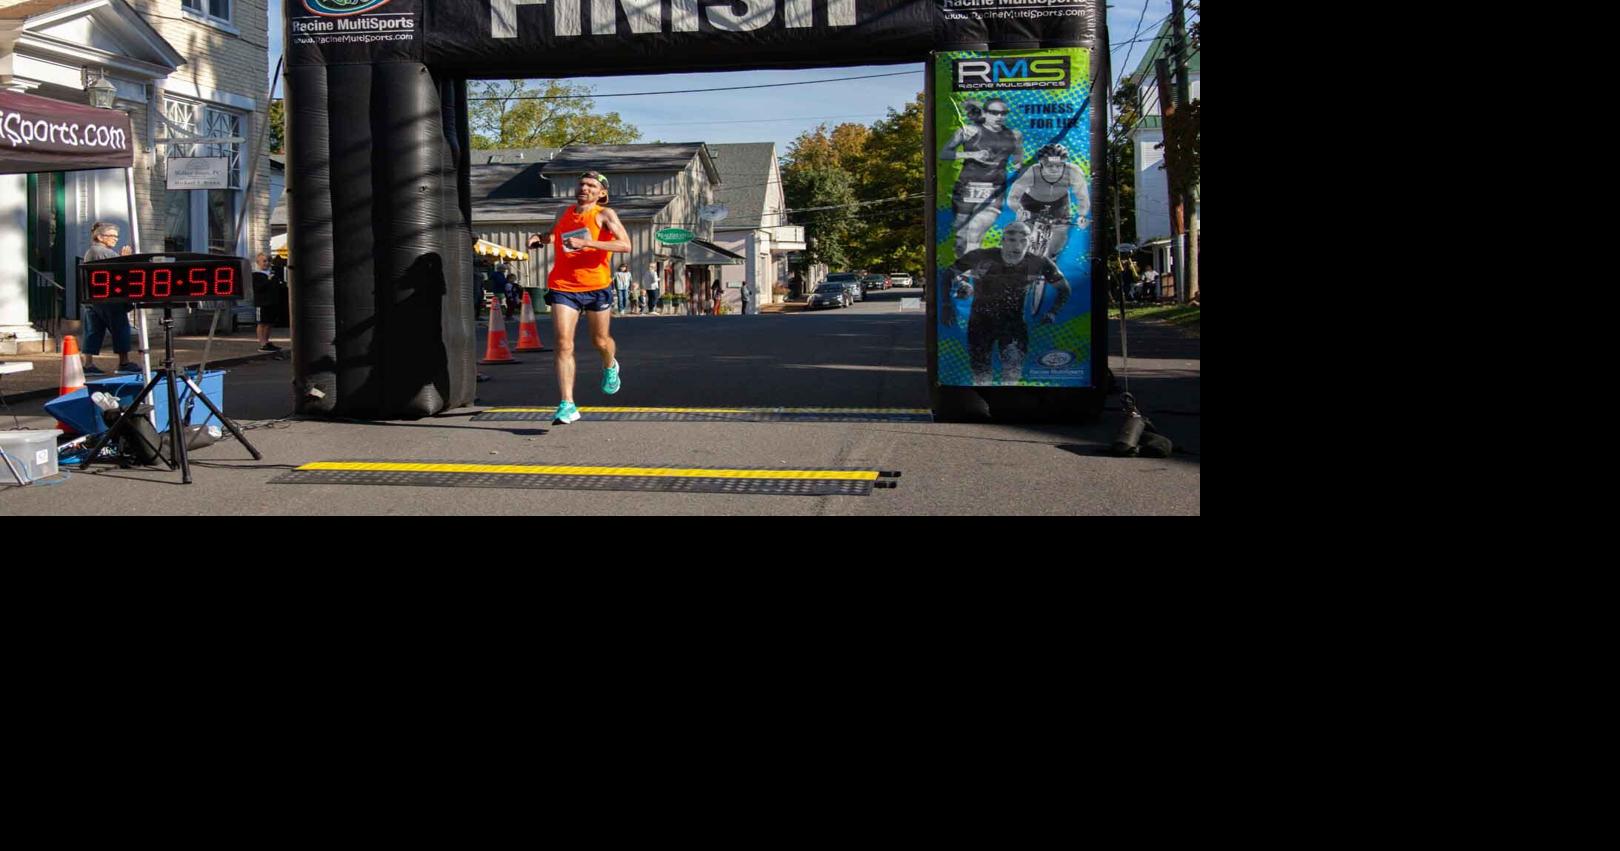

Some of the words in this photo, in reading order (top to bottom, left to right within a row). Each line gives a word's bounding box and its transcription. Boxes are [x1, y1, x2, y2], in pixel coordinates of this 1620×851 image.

[293, 20, 334, 32] Racine
[337, 17, 415, 30] MultiSports
[957, 59, 1066, 83] RMS
[1030, 118, 1053, 129] FOR
